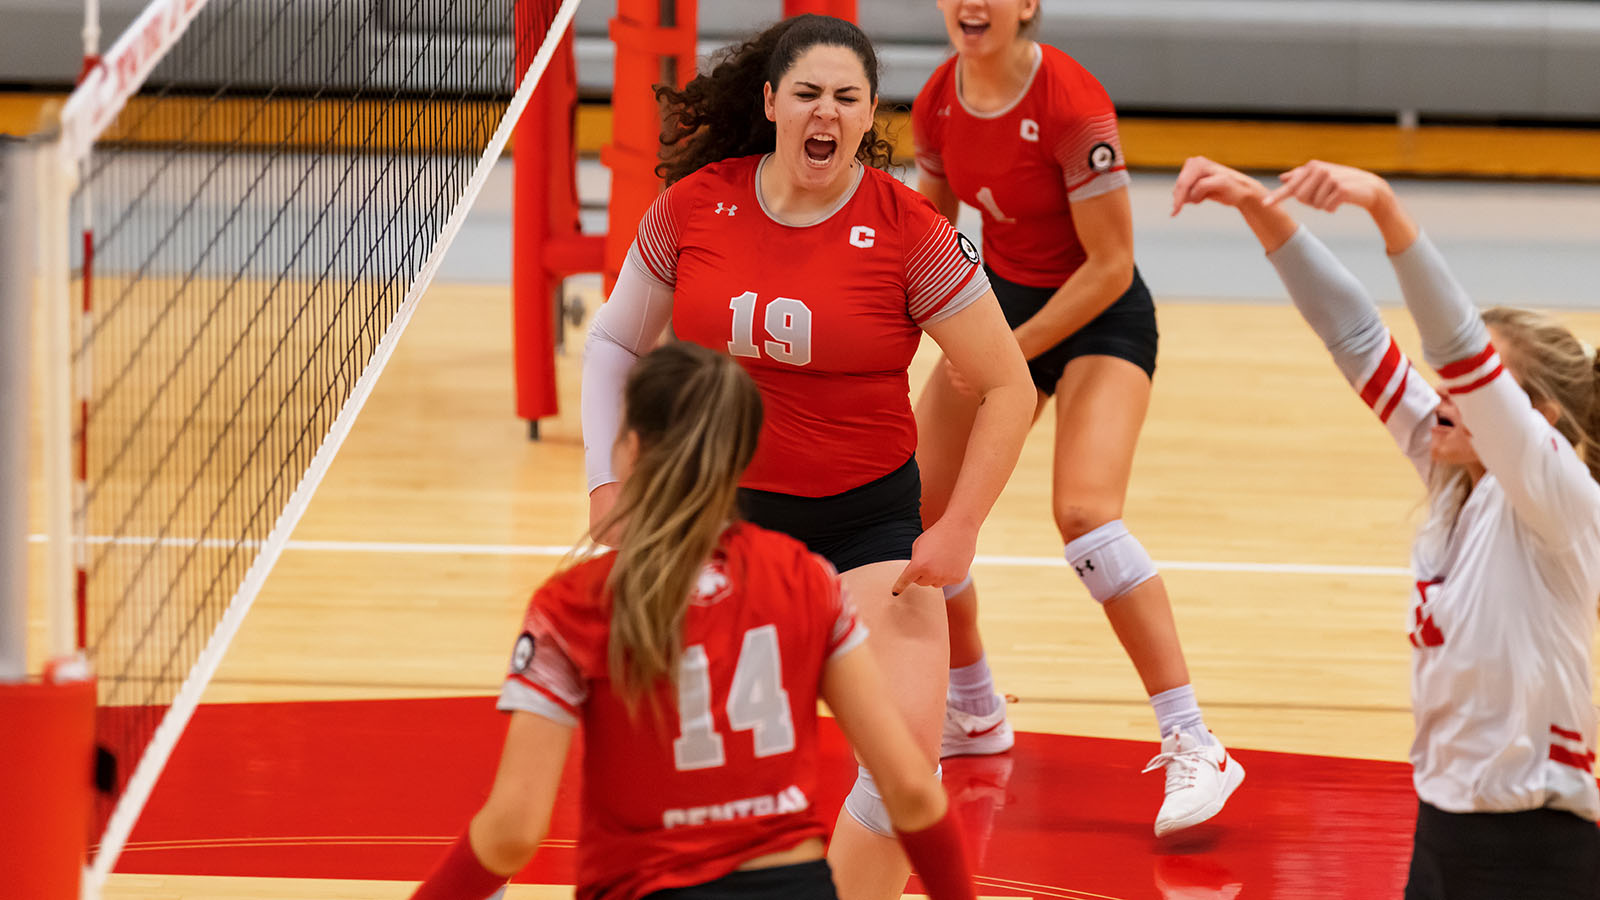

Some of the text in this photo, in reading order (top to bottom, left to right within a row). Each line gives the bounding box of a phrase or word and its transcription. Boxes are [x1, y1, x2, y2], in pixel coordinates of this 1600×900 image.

[1020, 119, 1039, 141] C
[850, 226, 875, 248] C
[727, 291, 812, 366] 19
[674, 624, 795, 771] 14
